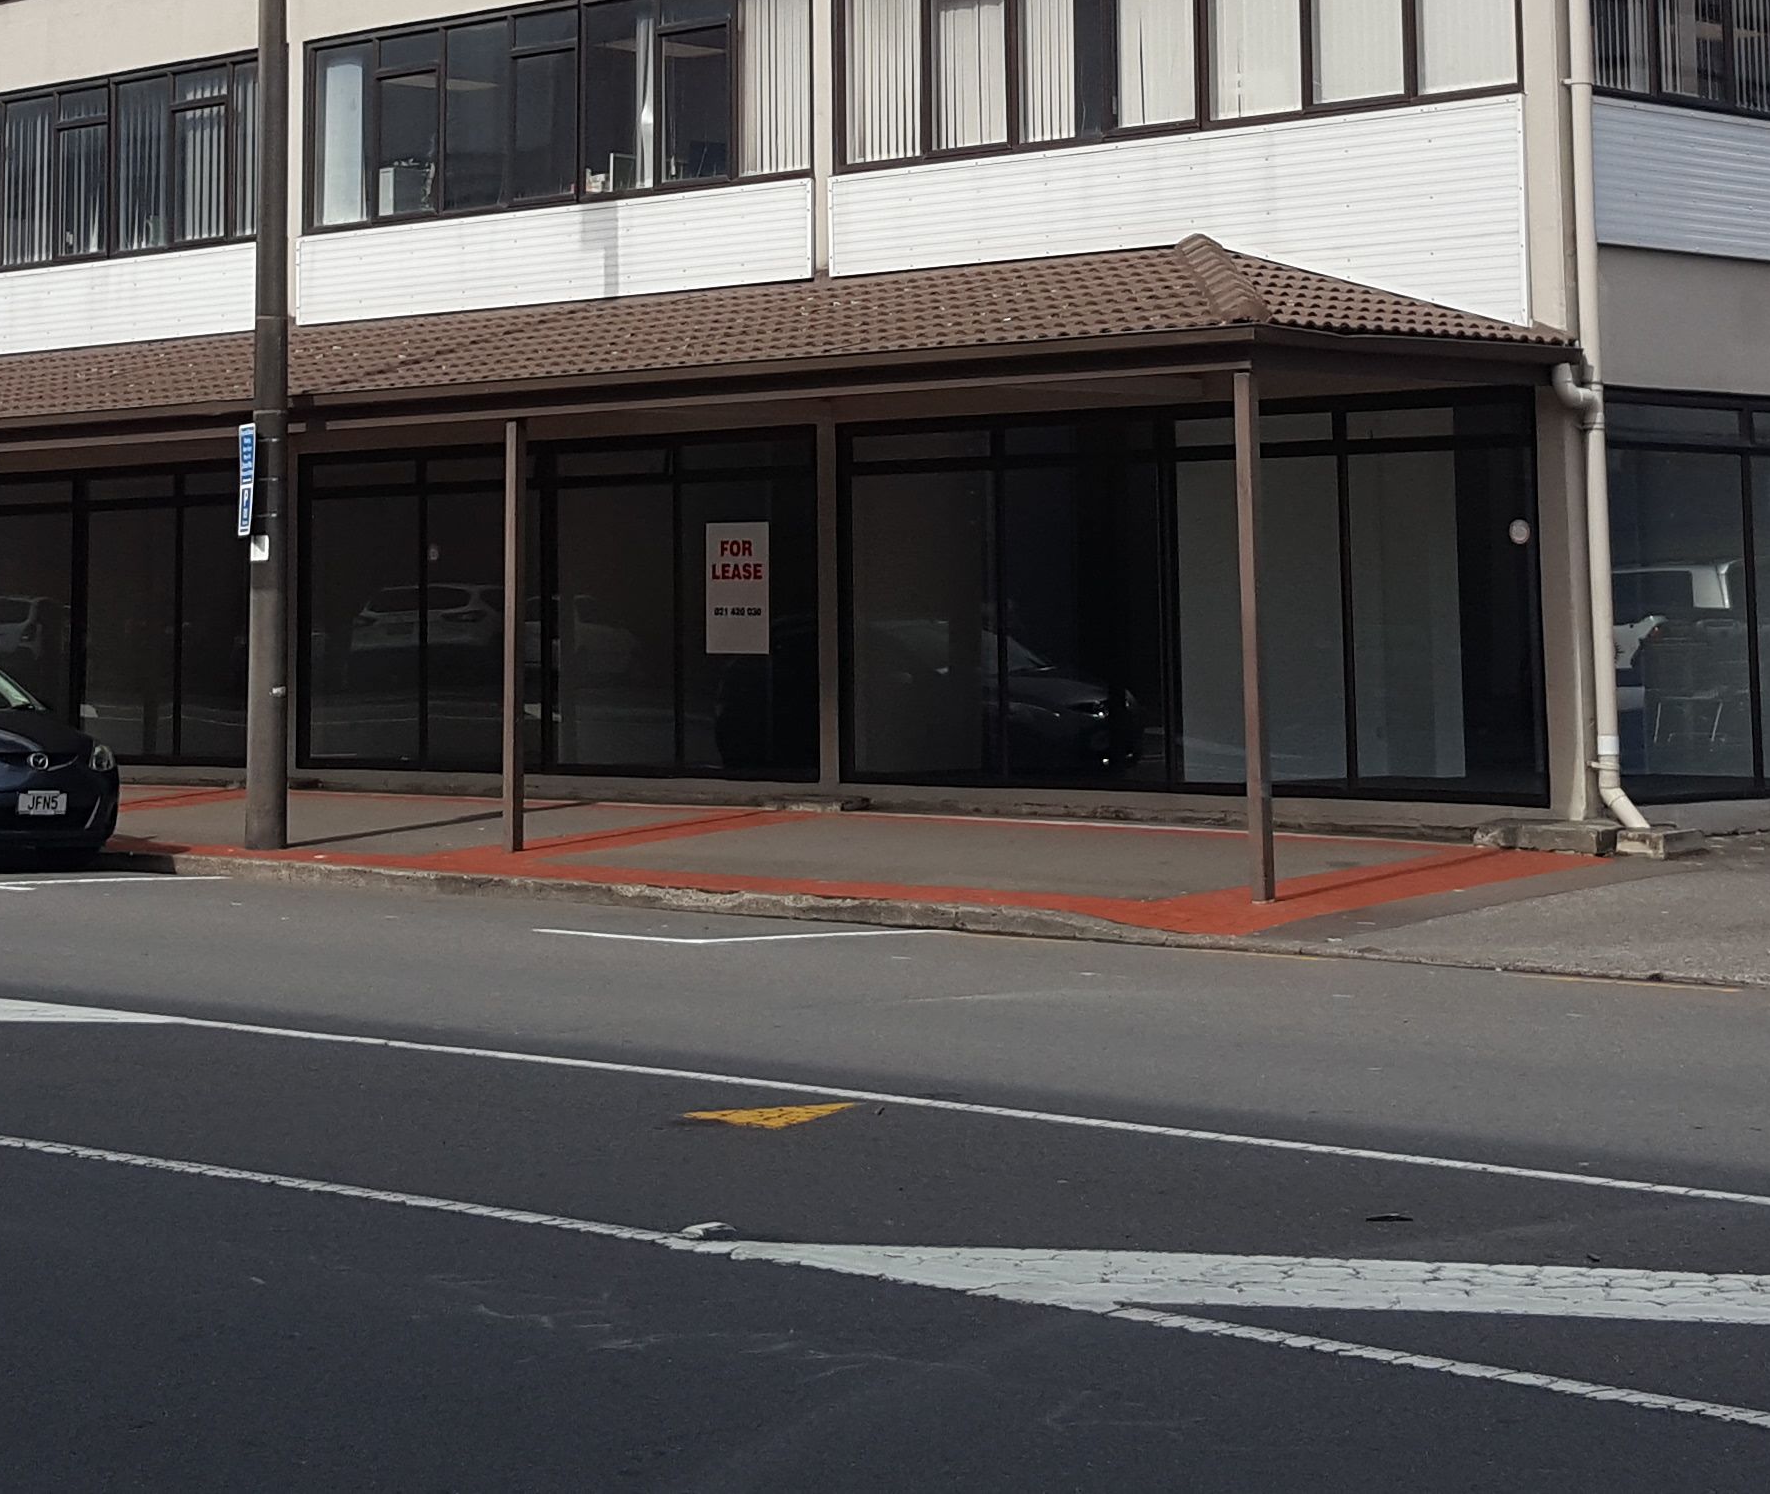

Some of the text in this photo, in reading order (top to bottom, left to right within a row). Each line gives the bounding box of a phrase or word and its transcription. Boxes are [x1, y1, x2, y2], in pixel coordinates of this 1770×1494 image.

[720, 540, 752, 557] FOR
[712, 563, 762, 580] LEASE
[28, 796, 58, 810] JFN5
